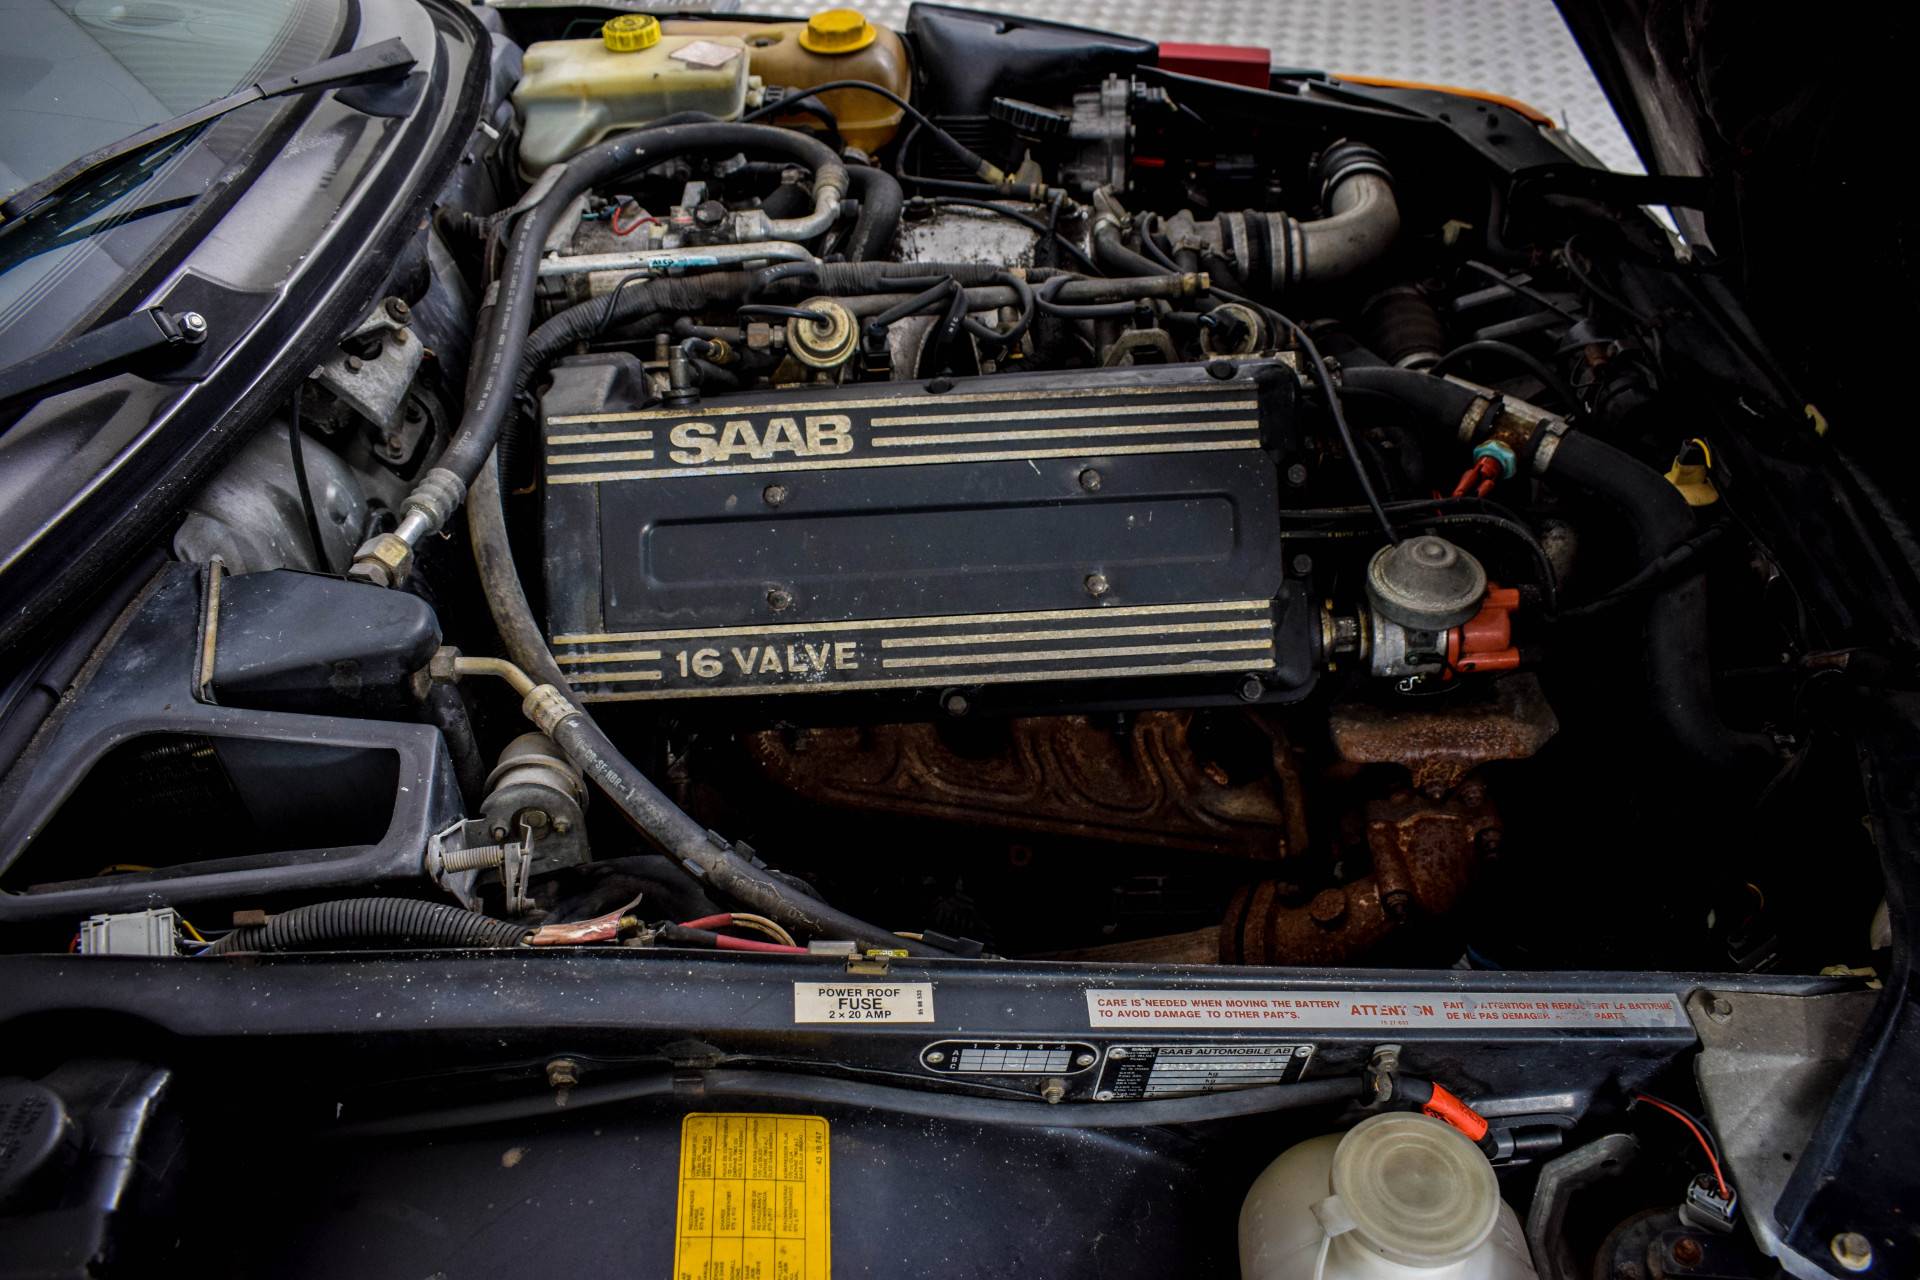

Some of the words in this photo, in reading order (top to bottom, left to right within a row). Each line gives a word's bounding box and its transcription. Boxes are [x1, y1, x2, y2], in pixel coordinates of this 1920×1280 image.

[669, 414, 855, 465] SAAB
[675, 648, 724, 679] 16
[732, 641, 859, 675] VALVE
[818, 988, 862, 997] POWER
[867, 988, 901, 997] ROOF
[838, 998, 883, 1010] FUSE
[1098, 999, 1127, 1007] CARE
[1131, 999, 1141, 1007] IS
[1226, 1000, 1268, 1008] MOVING
[1272, 1000, 1292, 1008] THE
[1295, 1000, 1340, 1008] BATTERY
[829, 1010, 835, 1018] 2
[848, 1010, 861, 1018] 20
[866, 1010, 892, 1018] AMP
[1117, 1010, 1150, 1018] AVOID
[1154, 1010, 1201, 1018] DAMAGE
[1207, 1010, 1221, 1018] TO
